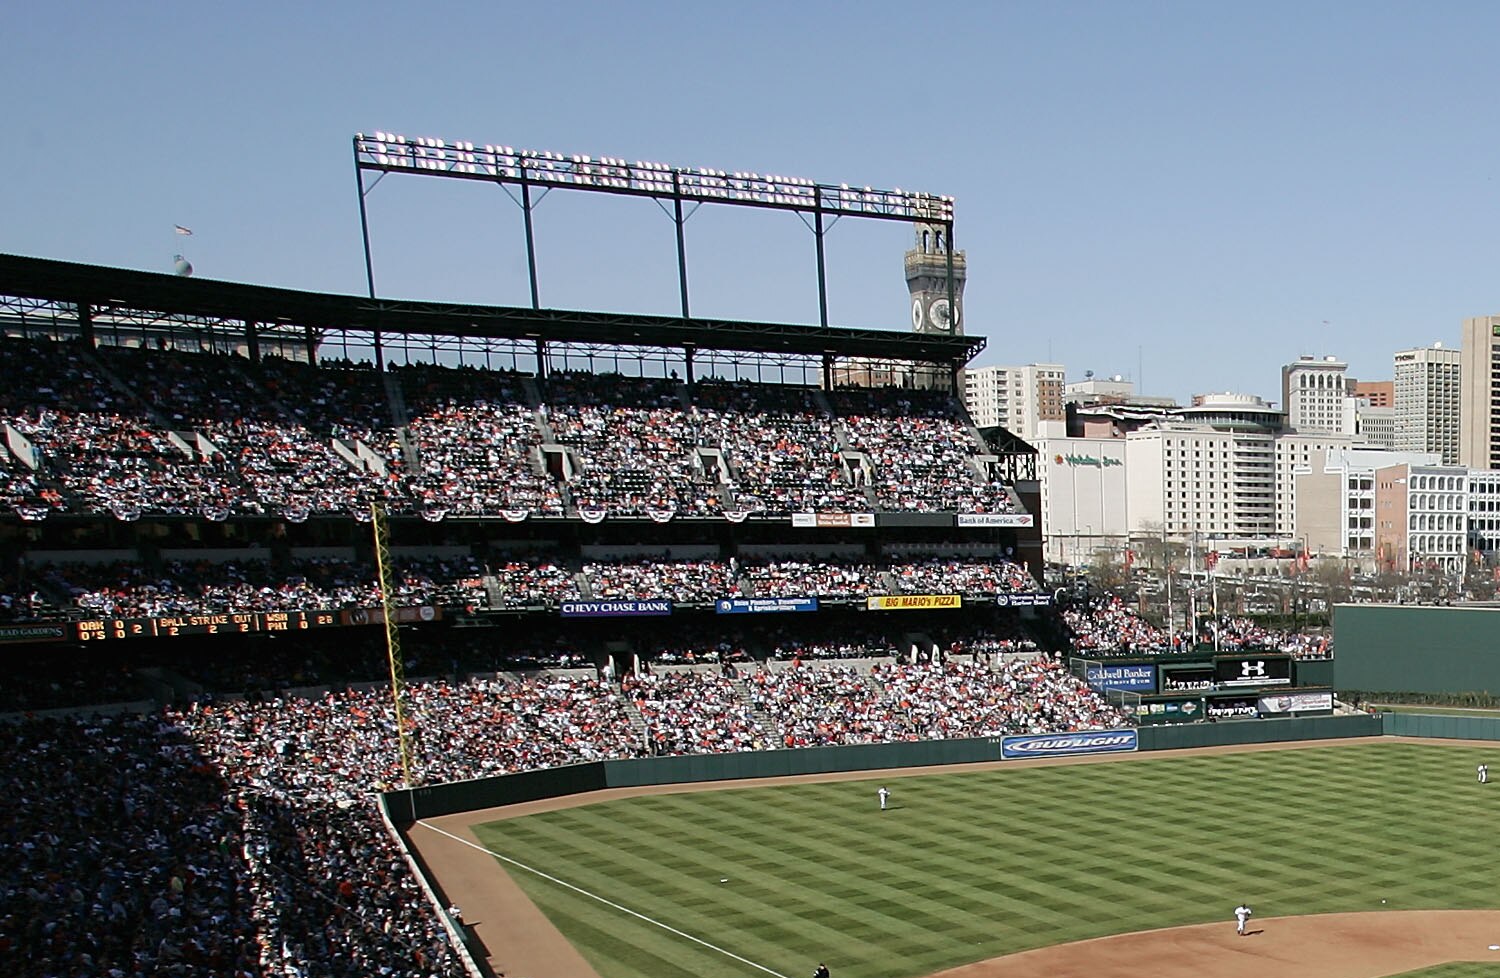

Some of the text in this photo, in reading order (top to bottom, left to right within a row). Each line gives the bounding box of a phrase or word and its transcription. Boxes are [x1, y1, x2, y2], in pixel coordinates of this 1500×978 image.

[563, 602, 668, 613] CHEVY CHASE BANK
[886, 597, 898, 607] BIG
[934, 597, 955, 606] PIZZA
[160, 614, 251, 627] BALL STRIKE OUT
[301, 621, 308, 629] 0
[79, 620, 142, 634] OAK 0 2
[170, 623, 249, 636] 2 2 2
[117, 630, 126, 639] 0
[1124, 668, 1152, 678] Banker
[1027, 735, 1135, 749] BUD LIGHT
